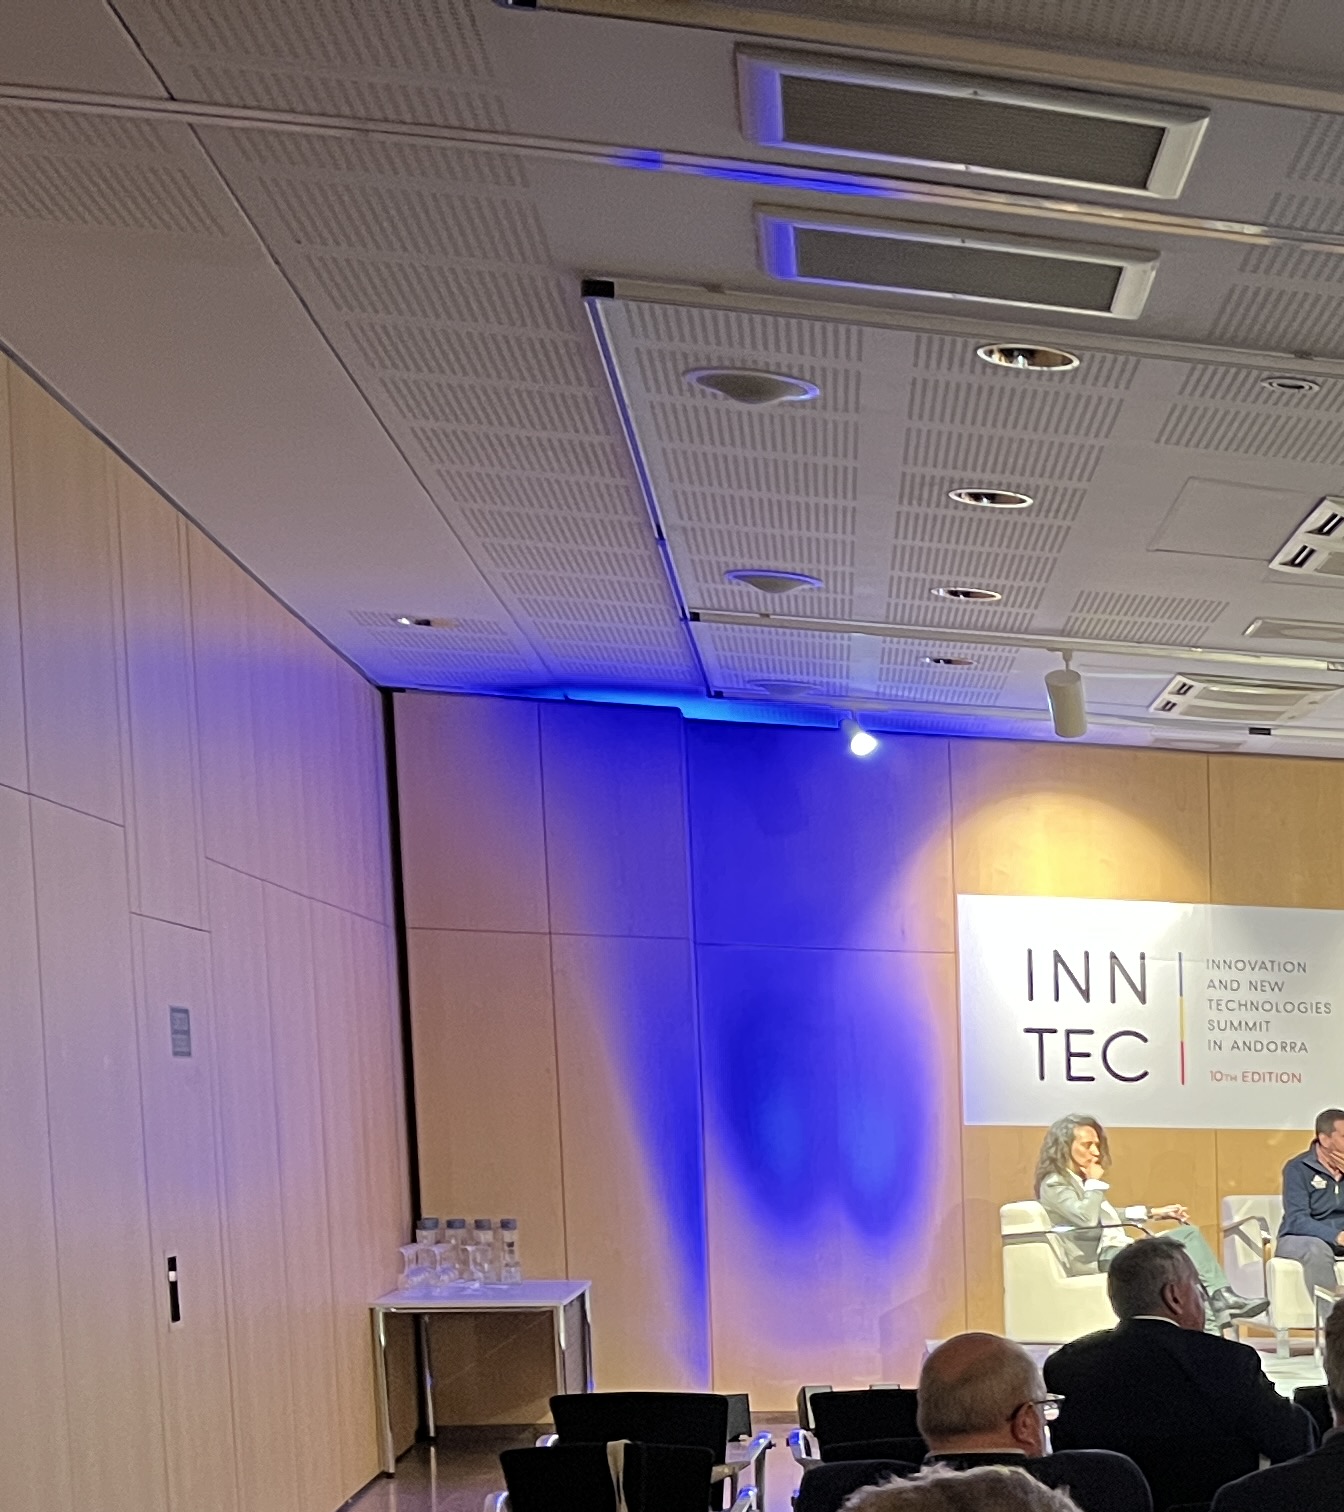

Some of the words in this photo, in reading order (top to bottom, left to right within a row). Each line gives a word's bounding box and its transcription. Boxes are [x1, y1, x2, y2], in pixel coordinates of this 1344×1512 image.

[1205, 957, 1308, 974] INNOVATION
[1026, 948, 1147, 1005] INN
[1206, 978, 1242, 993] AND
[1248, 979, 1286, 994] NEW
[1206, 998, 1333, 1015] TECHNOLOGIES
[1206, 1018, 1272, 1033] SUMMIT
[1022, 1027, 1150, 1083] TEC
[1207, 1038, 1223, 1052] IN
[1230, 1039, 1309, 1055] ANDORRA
[1241, 1069, 1303, 1084] EDITION
